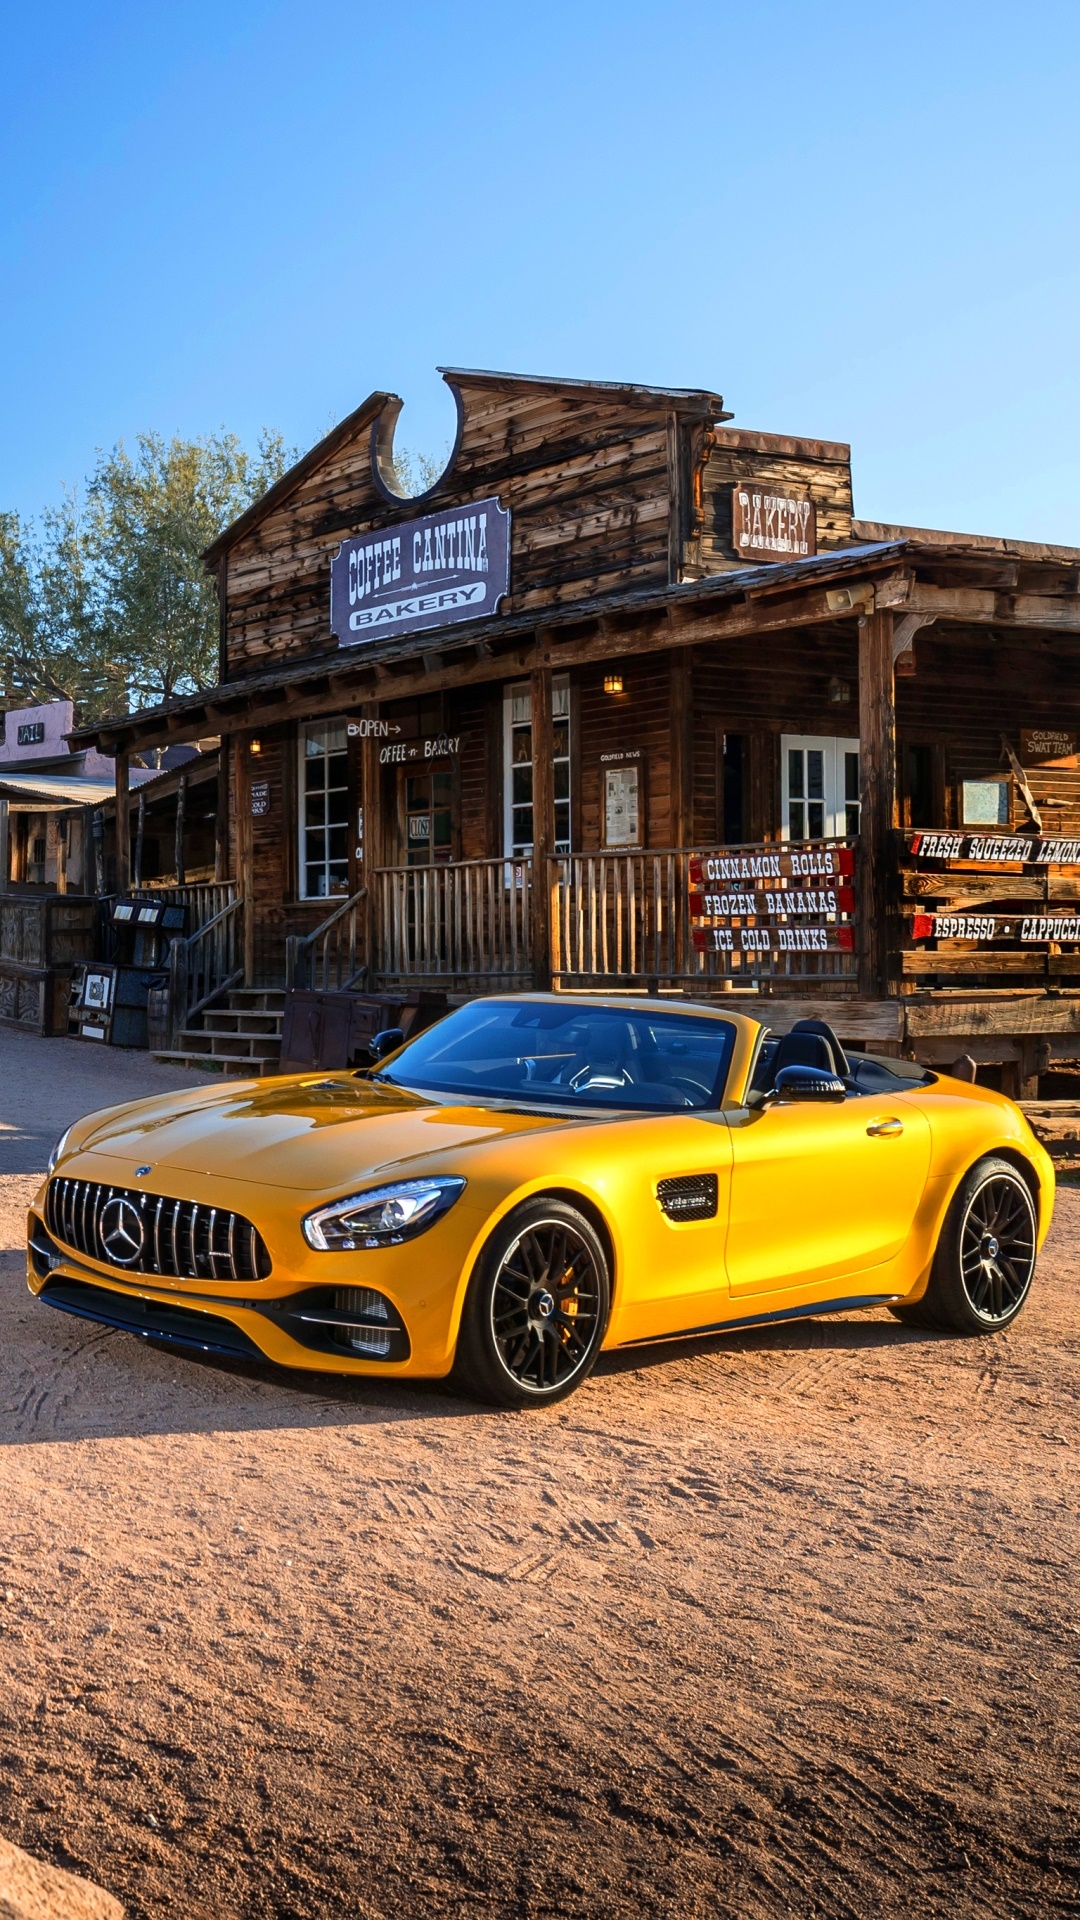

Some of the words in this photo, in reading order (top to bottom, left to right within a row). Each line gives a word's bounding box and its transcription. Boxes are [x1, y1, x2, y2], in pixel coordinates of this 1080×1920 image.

[739, 492, 810, 554] BAKERY
[349, 537, 400, 605] COFFEE
[413, 513, 488, 573] CANTINA
[355, 587, 478, 626] BAKERY
[19, 724, 41, 743] JAIL
[360, 719, 388, 737] OPEN
[1032, 731, 1069, 741] GOLDFIELD
[379, 744, 406, 764] OFFEE
[918, 835, 964, 859] FRESH
[968, 837, 1033, 861] SQUEEZED
[1036, 840, 1080, 863] LEMON
[707, 855, 781, 881] CINNAMON
[791, 852, 833, 875] ROLLS
[704, 893, 757, 915] FROZEN
[765, 891, 837, 914] BANANAS
[713, 929, 734, 951] ICE
[741, 929, 770, 951] COLD
[778, 929, 828, 951] DRINKS
[933, 917, 995, 940] ESPRESSO
